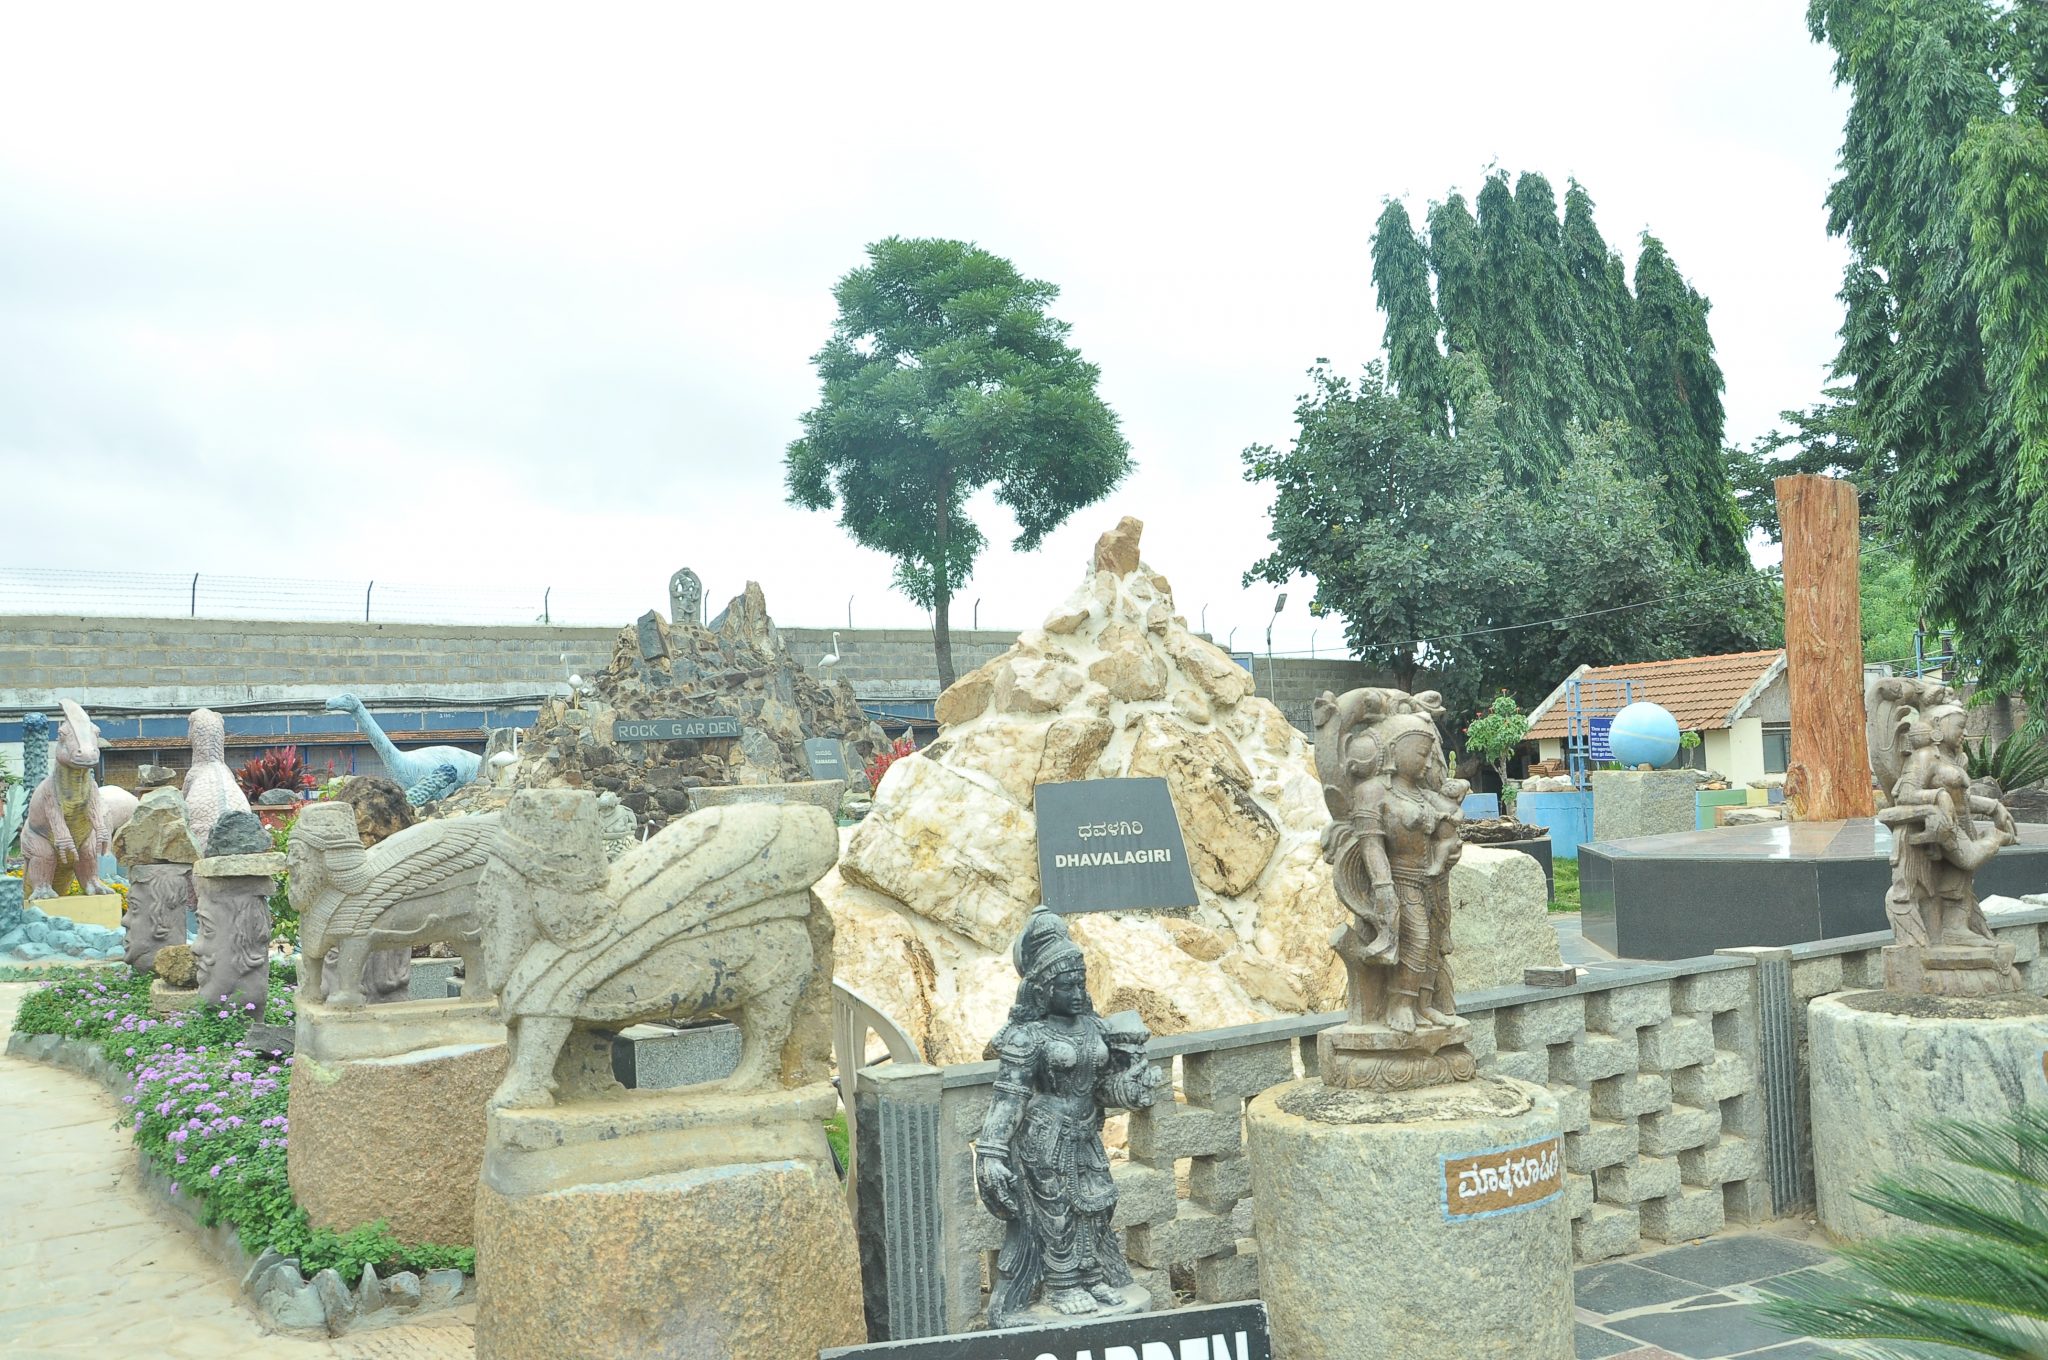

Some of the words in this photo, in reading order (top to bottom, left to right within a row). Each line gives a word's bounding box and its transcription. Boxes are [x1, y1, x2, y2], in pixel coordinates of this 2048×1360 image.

[618, 724, 660, 738] ROCK
[671, 721, 738, 736] GARDEN
[1077, 820, 1144, 841] ಧವಳಗಿರಿ
[1055, 849, 1172, 868] DHAVALAGIRI
